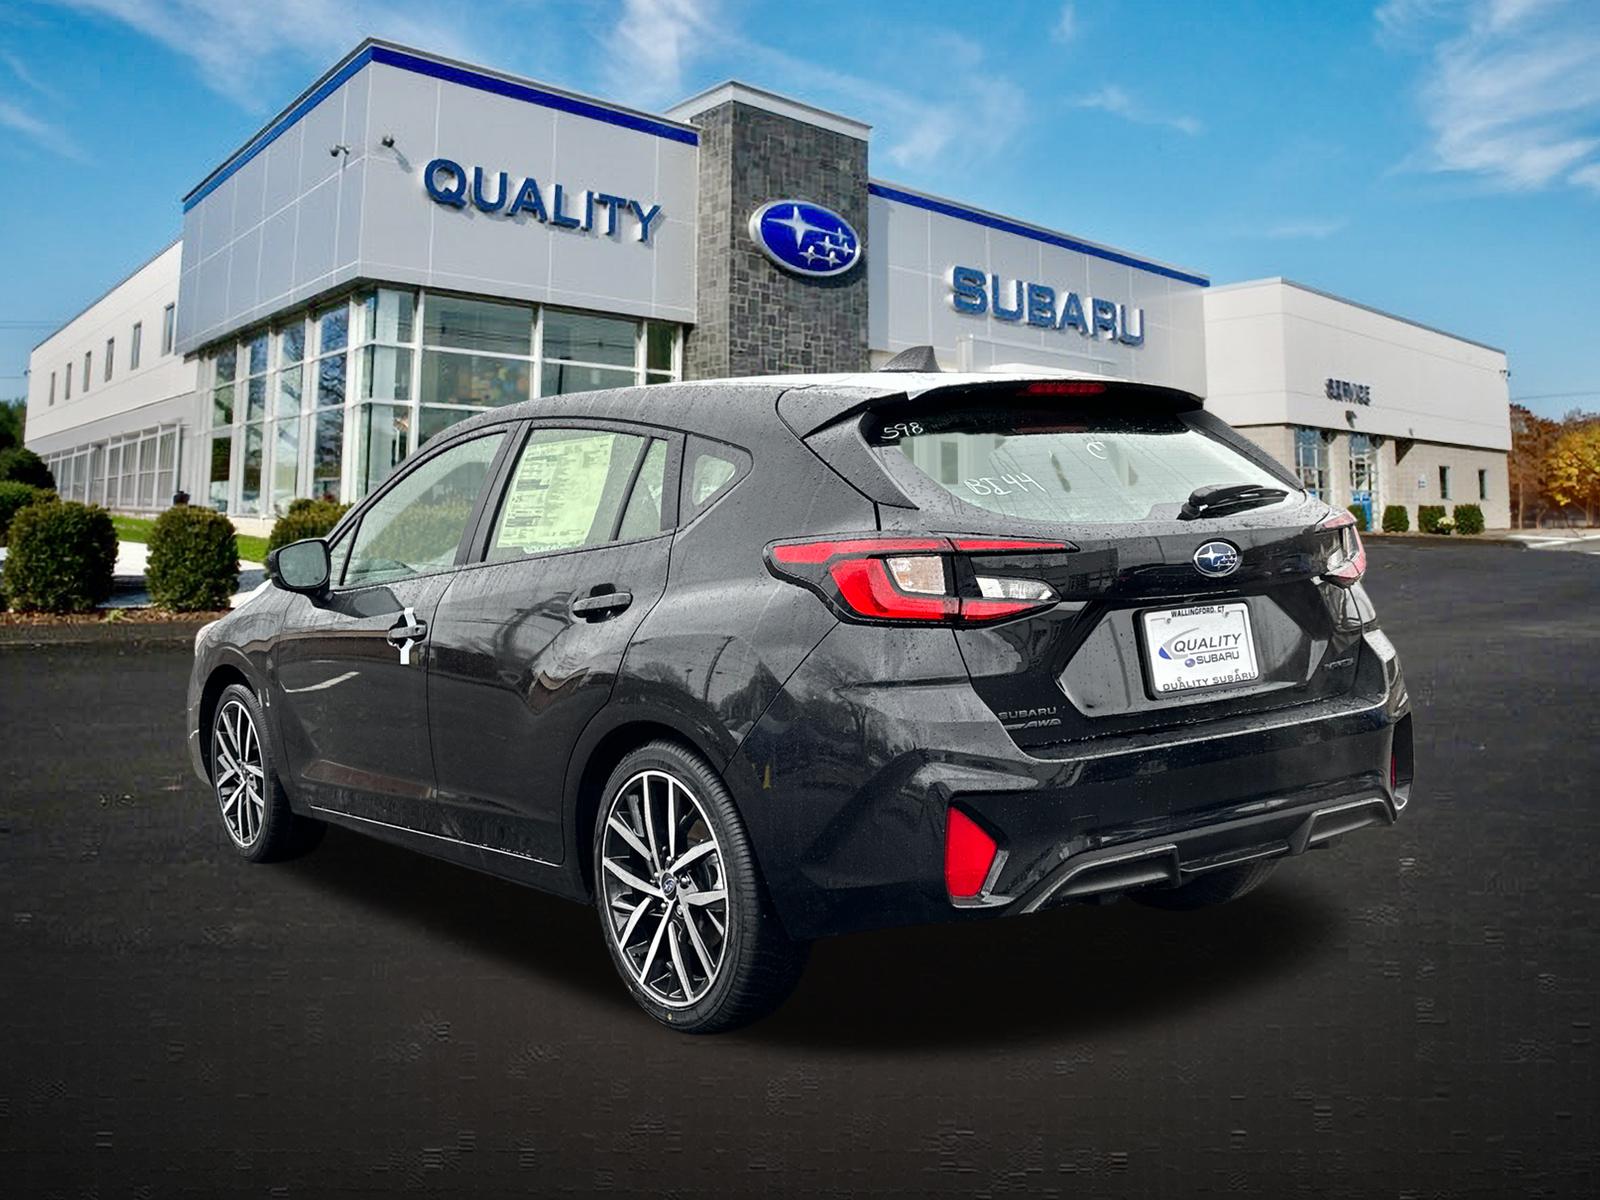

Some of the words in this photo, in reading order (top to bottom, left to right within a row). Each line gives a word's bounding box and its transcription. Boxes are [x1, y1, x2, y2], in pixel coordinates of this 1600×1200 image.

[423, 158, 661, 243] QUALITY
[951, 265, 1145, 346] SUBARU
[1325, 378, 1371, 406] SERVICE
[880, 422, 923, 439] 598
[1217, 605, 1225, 613] CT
[1174, 633, 1241, 652] QUALITY
[1196, 651, 1240, 665] SUBARU
[1162, 678, 1208, 690] QUALITY
[1212, 671, 1256, 684] SUBARU
[998, 706, 1057, 719] SUBARU
[1024, 718, 1062, 729] AWD
